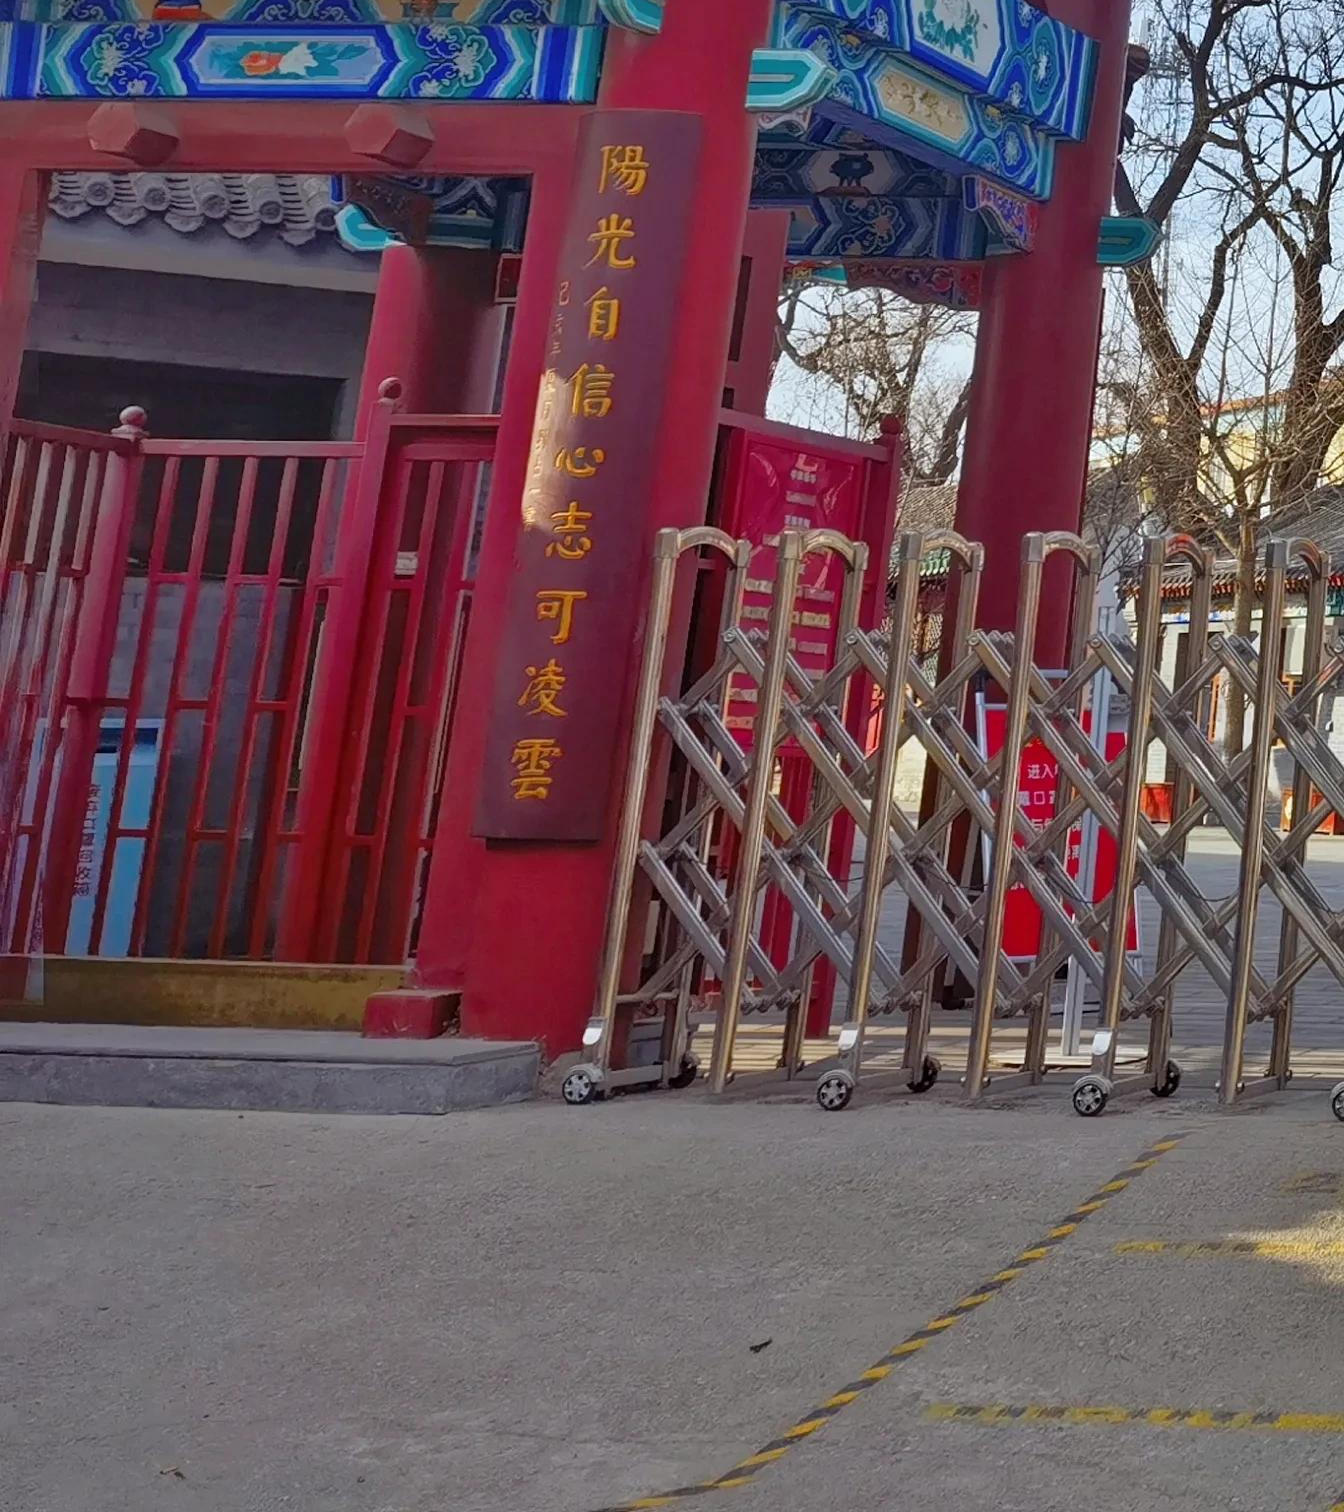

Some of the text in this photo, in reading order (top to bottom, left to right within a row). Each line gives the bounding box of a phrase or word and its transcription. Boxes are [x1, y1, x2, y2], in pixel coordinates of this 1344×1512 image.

[511, 144, 650, 801] 陽光自信心志可凌雲
